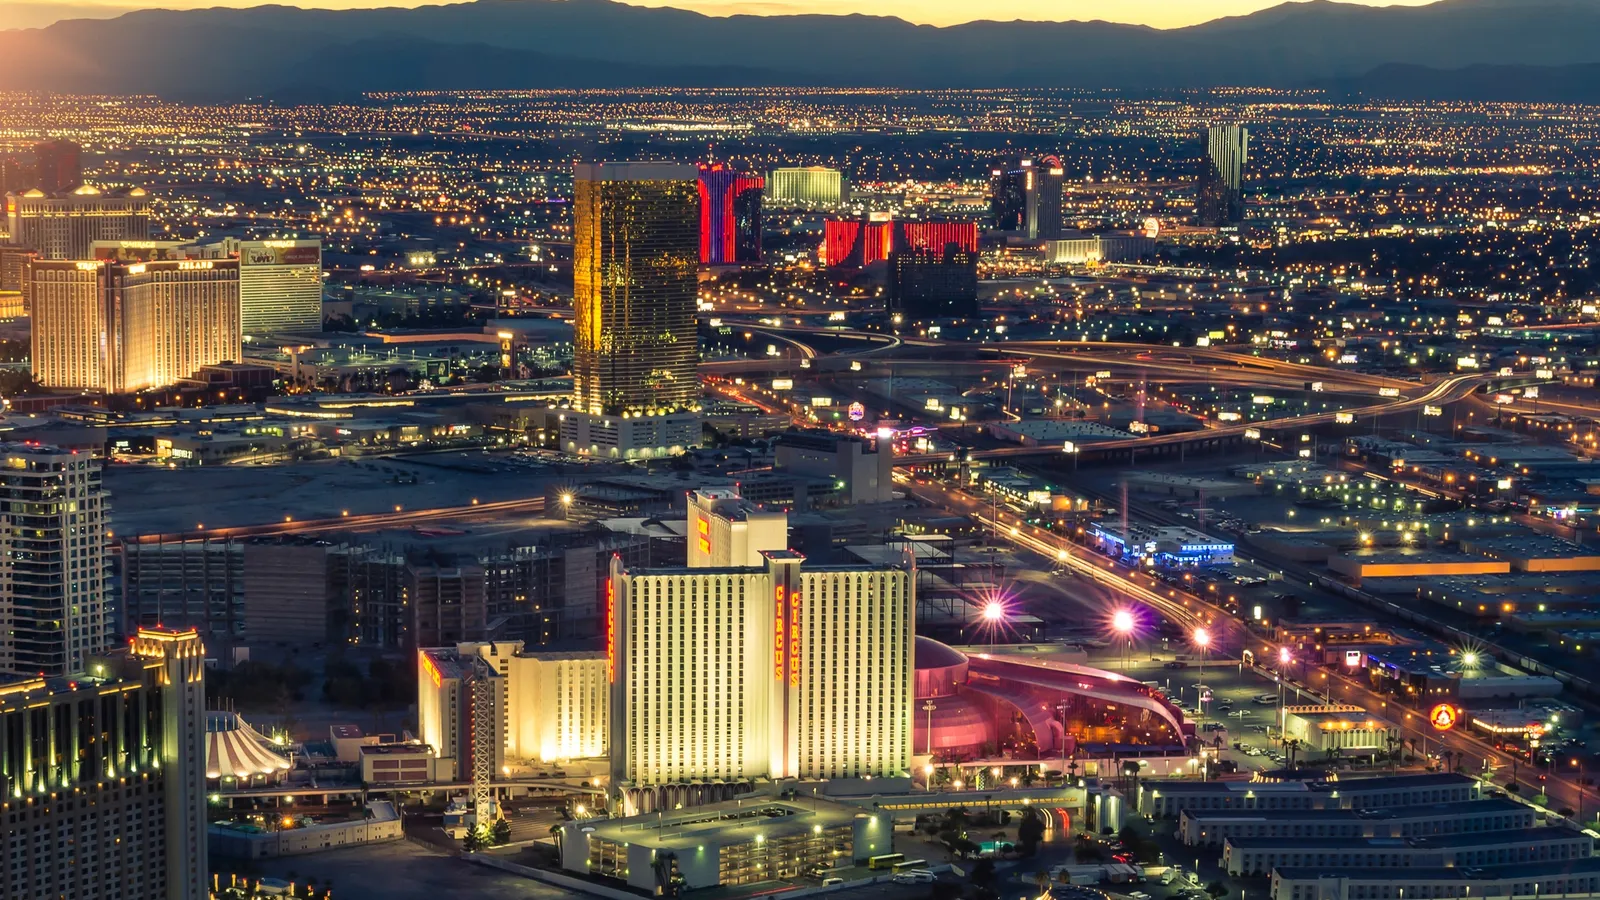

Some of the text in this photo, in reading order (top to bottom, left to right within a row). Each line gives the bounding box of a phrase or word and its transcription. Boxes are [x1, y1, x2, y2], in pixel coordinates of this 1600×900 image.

[178, 261, 214, 270] ISLAND
[775, 585, 784, 681] CIRCUS
[790, 592, 799, 688] CIRCUS
